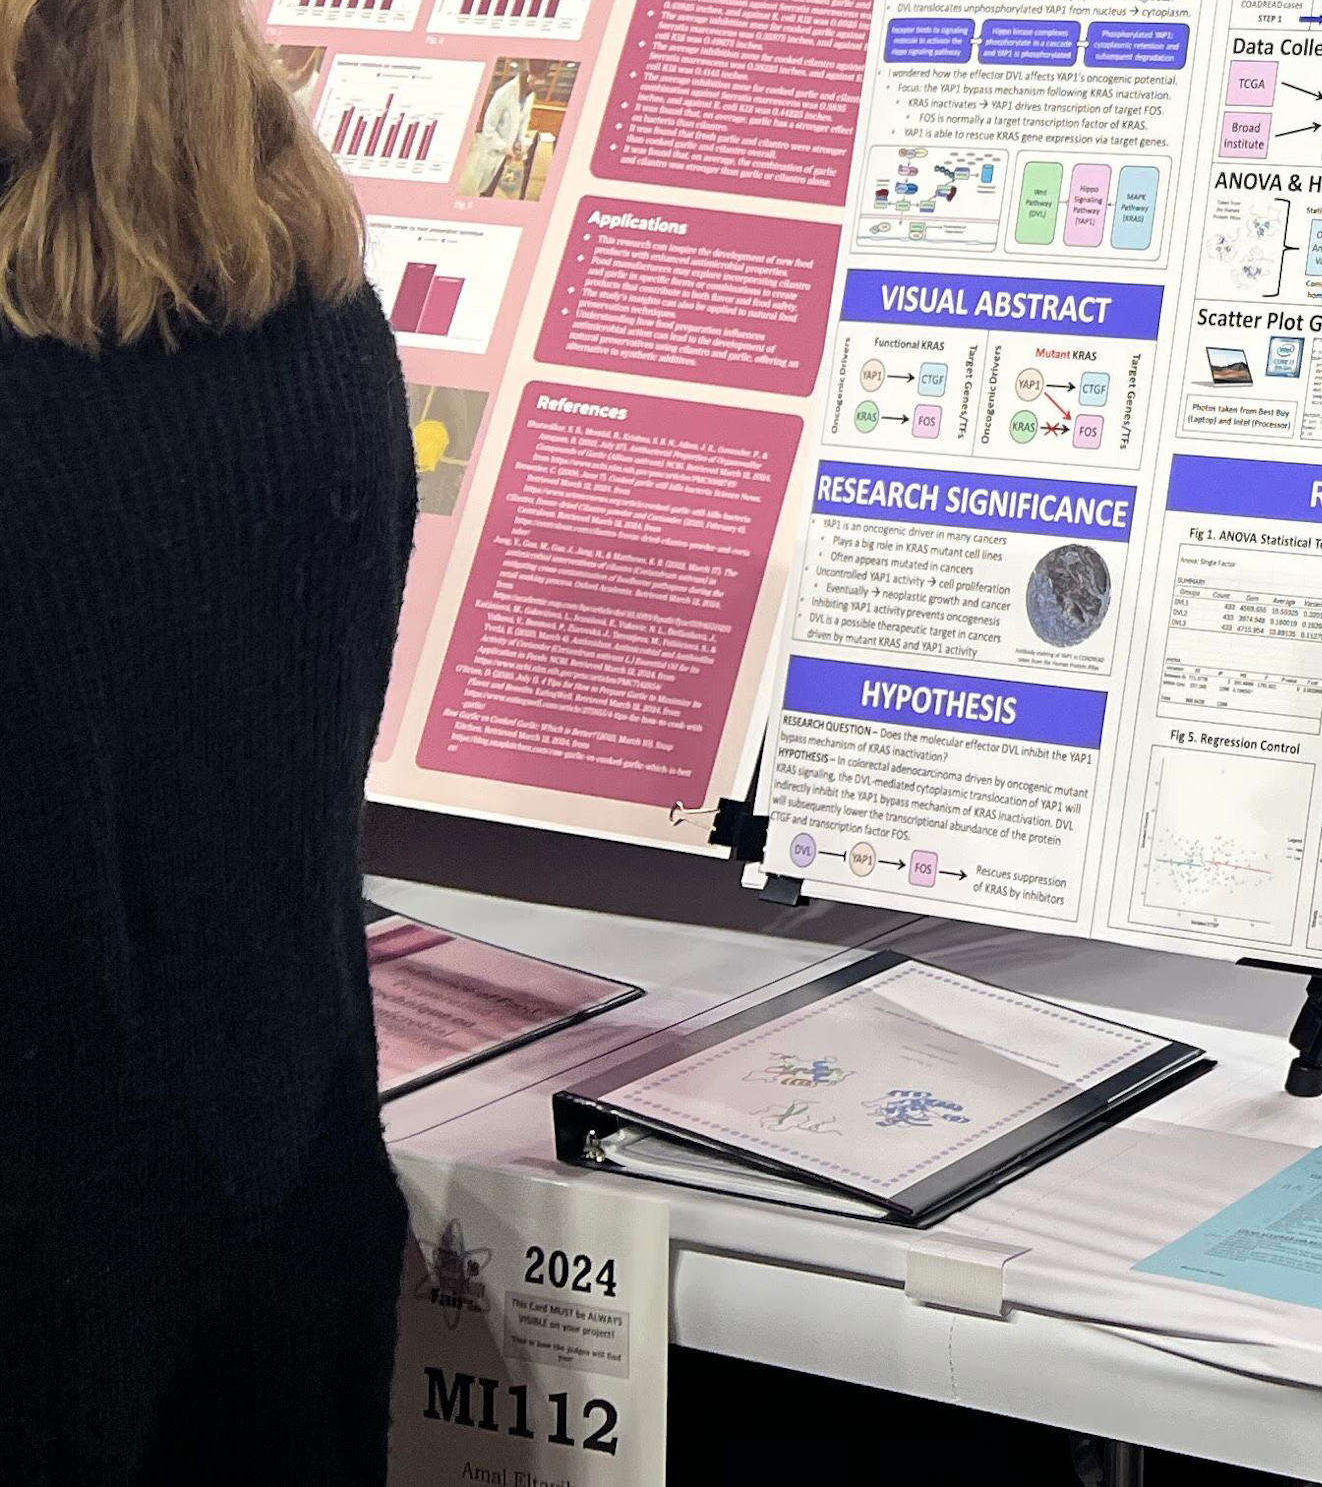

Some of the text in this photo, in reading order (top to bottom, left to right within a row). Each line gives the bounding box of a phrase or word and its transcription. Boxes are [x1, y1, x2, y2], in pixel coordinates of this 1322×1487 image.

[1233, 38, 1274, 55] Data
[1214, 172, 1280, 191] ANOVA
[1288, 174, 1302, 192] &
[587, 211, 688, 235] Applications
[882, 285, 1113, 324] VISUAL ABSTRACT
[1197, 308, 1262, 329] Scatter
[1267, 311, 1304, 331] Plot
[536, 396, 628, 421] References
[818, 475, 1129, 528] RESEARCH SIGNIFICANCE
[861, 680, 1017, 725] HYPOTHESIS
[525, 1246, 616, 1297] 2024
[424, 1366, 618, 1456] MI112
[462, 1462, 507, 1485] Amal
